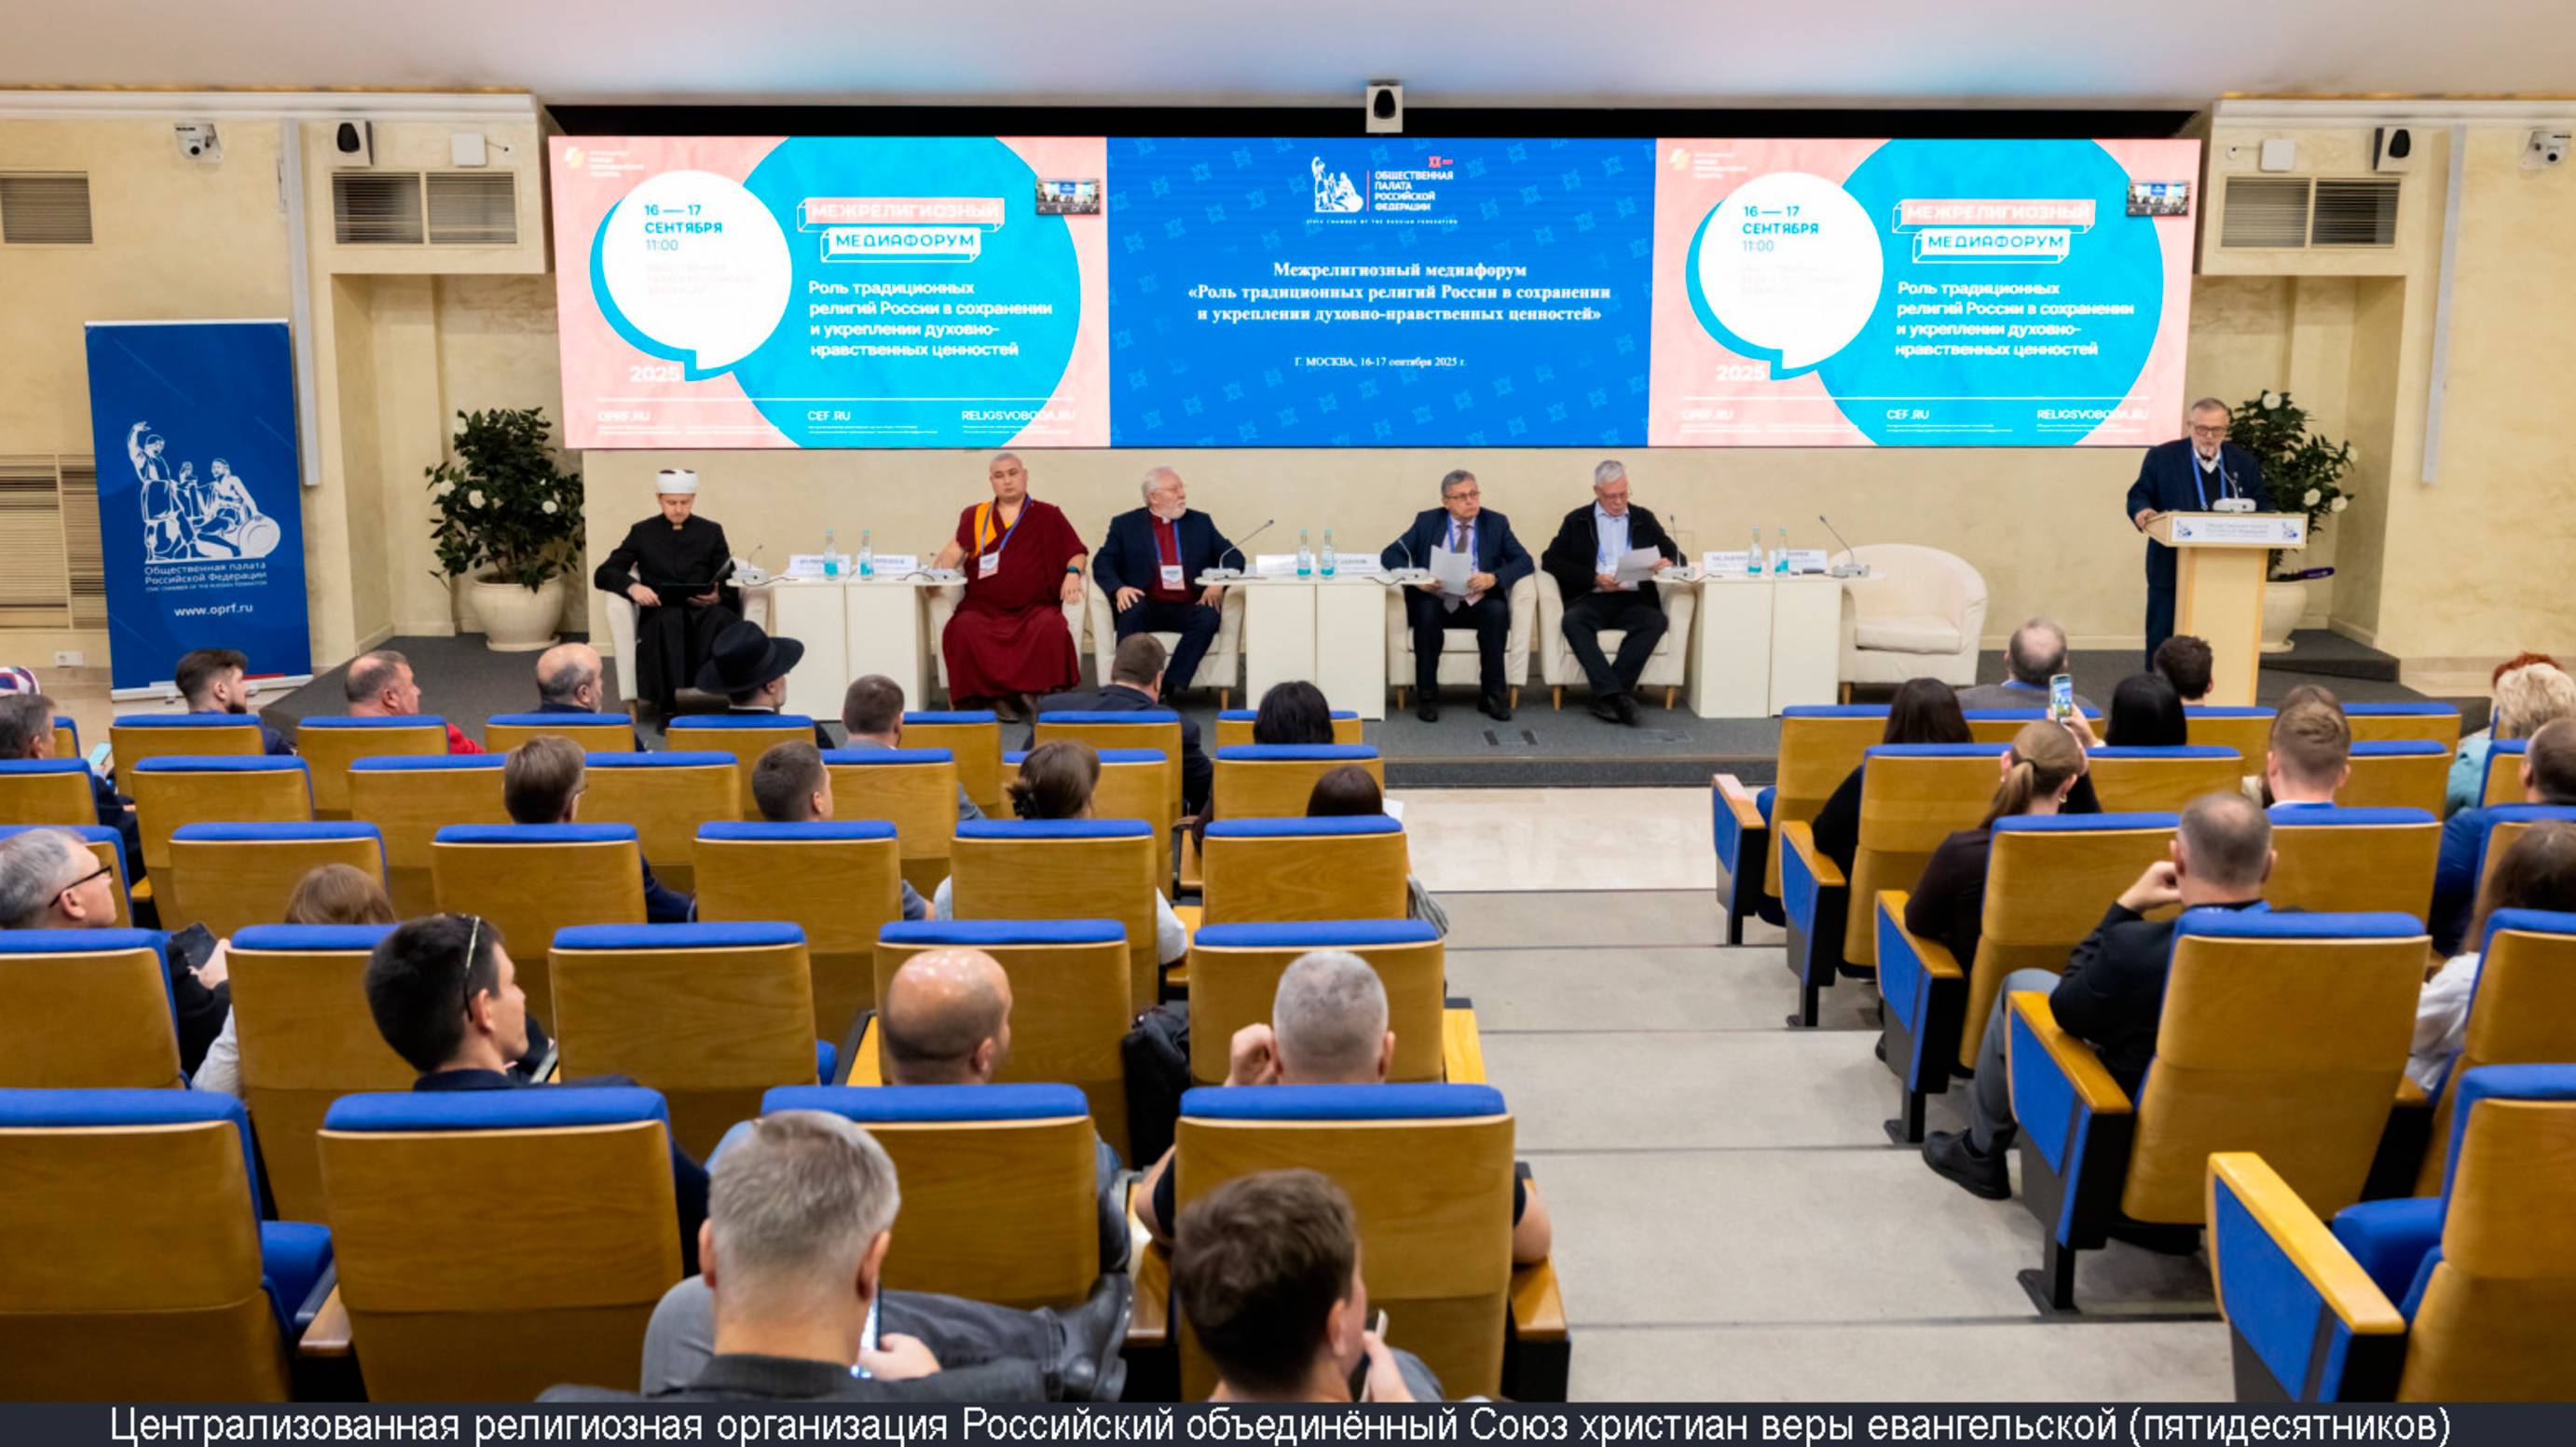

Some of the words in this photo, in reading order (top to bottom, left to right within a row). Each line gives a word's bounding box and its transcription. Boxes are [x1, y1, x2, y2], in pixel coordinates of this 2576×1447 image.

[1375, 171, 1454, 181] ОБЩЕСТВЕННАЯ
[1375, 182, 1413, 190] ПАЛАТА
[1375, 191, 1435, 201] РОССИЙСКОЙ
[644, 204, 660, 216] 16
[688, 204, 702, 215] 17
[811, 201, 1001, 219] МЕЖРЕЛИГИОЗНЫЙ
[1375, 202, 1432, 212] ФЕДЕРАЦИИ
[1744, 206, 1759, 217] 16
[1786, 206, 1801, 217] 17
[1907, 202, 2090, 220] МЕЖРЕЛИГИОЗНЫЙ
[644, 222, 723, 234] СЕНТЯБРЯ
[1742, 223, 1820, 235] СЕНТЯБРЯ
[645, 239, 679, 251] 11:00
[835, 234, 975, 248] МЕДИАФОРУМ
[1742, 239, 1774, 252] 11:00
[1927, 235, 2064, 248] МЕДИАФОРУМ
[1273, 262, 1421, 280] Межрелигиозный
[1425, 263, 1528, 280] медиафорум
[808, 280, 850, 294] Роль
[852, 282, 975, 296] традиционных
[1188, 284, 1237, 299] «Роль
[1240, 287, 1363, 303] традиционных
[1368, 284, 1436, 303] религий
[1441, 284, 1498, 299] России
[1501, 288, 1512, 299] в
[1515, 287, 1611, 303] сохранении
[1898, 280, 1938, 295] Роль
[1940, 282, 2061, 296] традиционных
[809, 301, 878, 317] религий
[880, 301, 940, 315] России
[942, 305, 952, 315] в
[955, 304, 1053, 317] сохранении
[1197, 309, 1208, 321] и
[1212, 309, 1311, 324] укреплении
[1314, 309, 1504, 324] духовно-нравственных
[1508, 307, 1602, 322] ценностей»
[1897, 301, 1963, 317] религий
[1966, 301, 2024, 315] России
[2027, 305, 2037, 315] в
[2039, 304, 2135, 317] сохранении
[810, 325, 820, 335] и
[824, 325, 922, 339] укреплении
[925, 325, 1000, 339] духовно-
[1896, 325, 1906, 335] и
[1909, 325, 2006, 339] укреплении
[2007, 325, 2081, 339] духовно-
[811, 346, 928, 360] нравственных
[932, 342, 1020, 358] ценностей
[1895, 345, 2010, 359] нравственных
[2013, 342, 2099, 358] ценностей
[1305, 356, 1358, 368] МОСКВА,
[1360, 357, 1387, 367] 16-17
[1388, 356, 1432, 369] сентября
[1433, 356, 1458, 367] 2025
[629, 365, 681, 383] 2025
[1715, 365, 1766, 381] 2025
[144, 565, 226, 576] Общественная
[229, 562, 267, 571] палата
[144, 574, 205, 585] Российской
[208, 572, 267, 582] Федерации
[173, 602, 253, 617] www.oprf.ru
